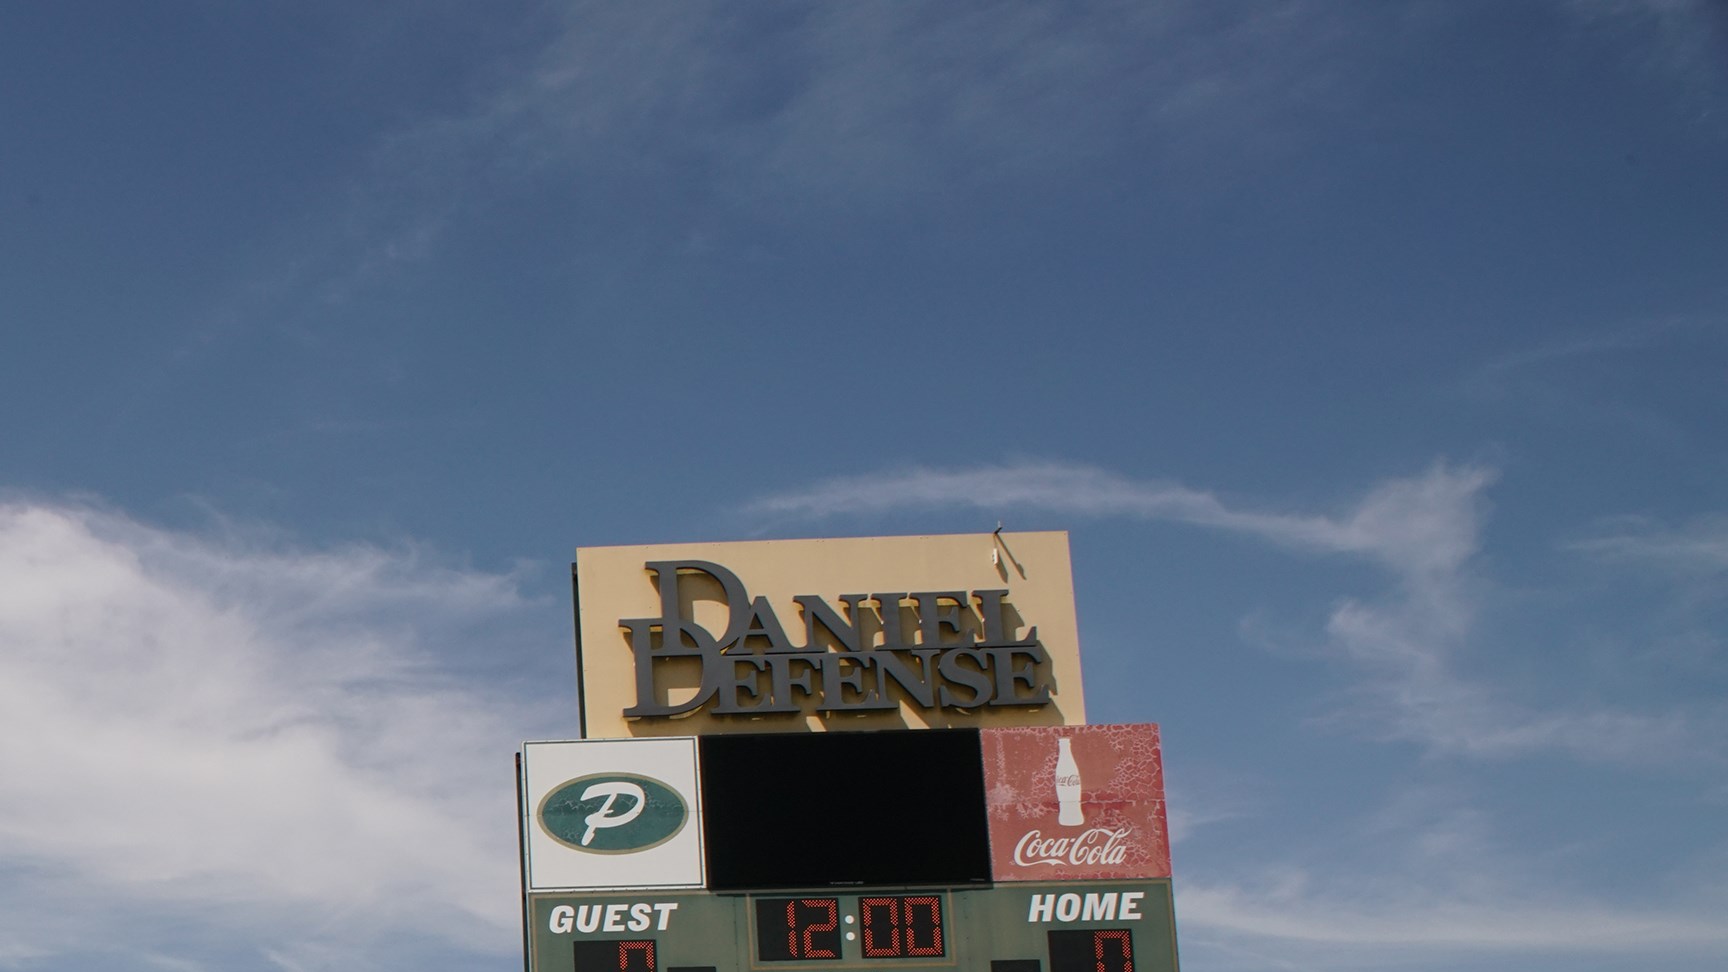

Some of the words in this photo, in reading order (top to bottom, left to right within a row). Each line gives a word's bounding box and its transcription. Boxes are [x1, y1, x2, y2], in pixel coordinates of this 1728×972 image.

[644, 560, 1038, 656] DANIEL
[618, 618, 1052, 718] DEFENSE
[580, 781, 646, 846] P
[1013, 827, 1134, 867] Coca-Cola
[548, 902, 679, 934] GUEST
[786, 897, 943, 958] 12:00
[1027, 891, 1145, 923] HOME
